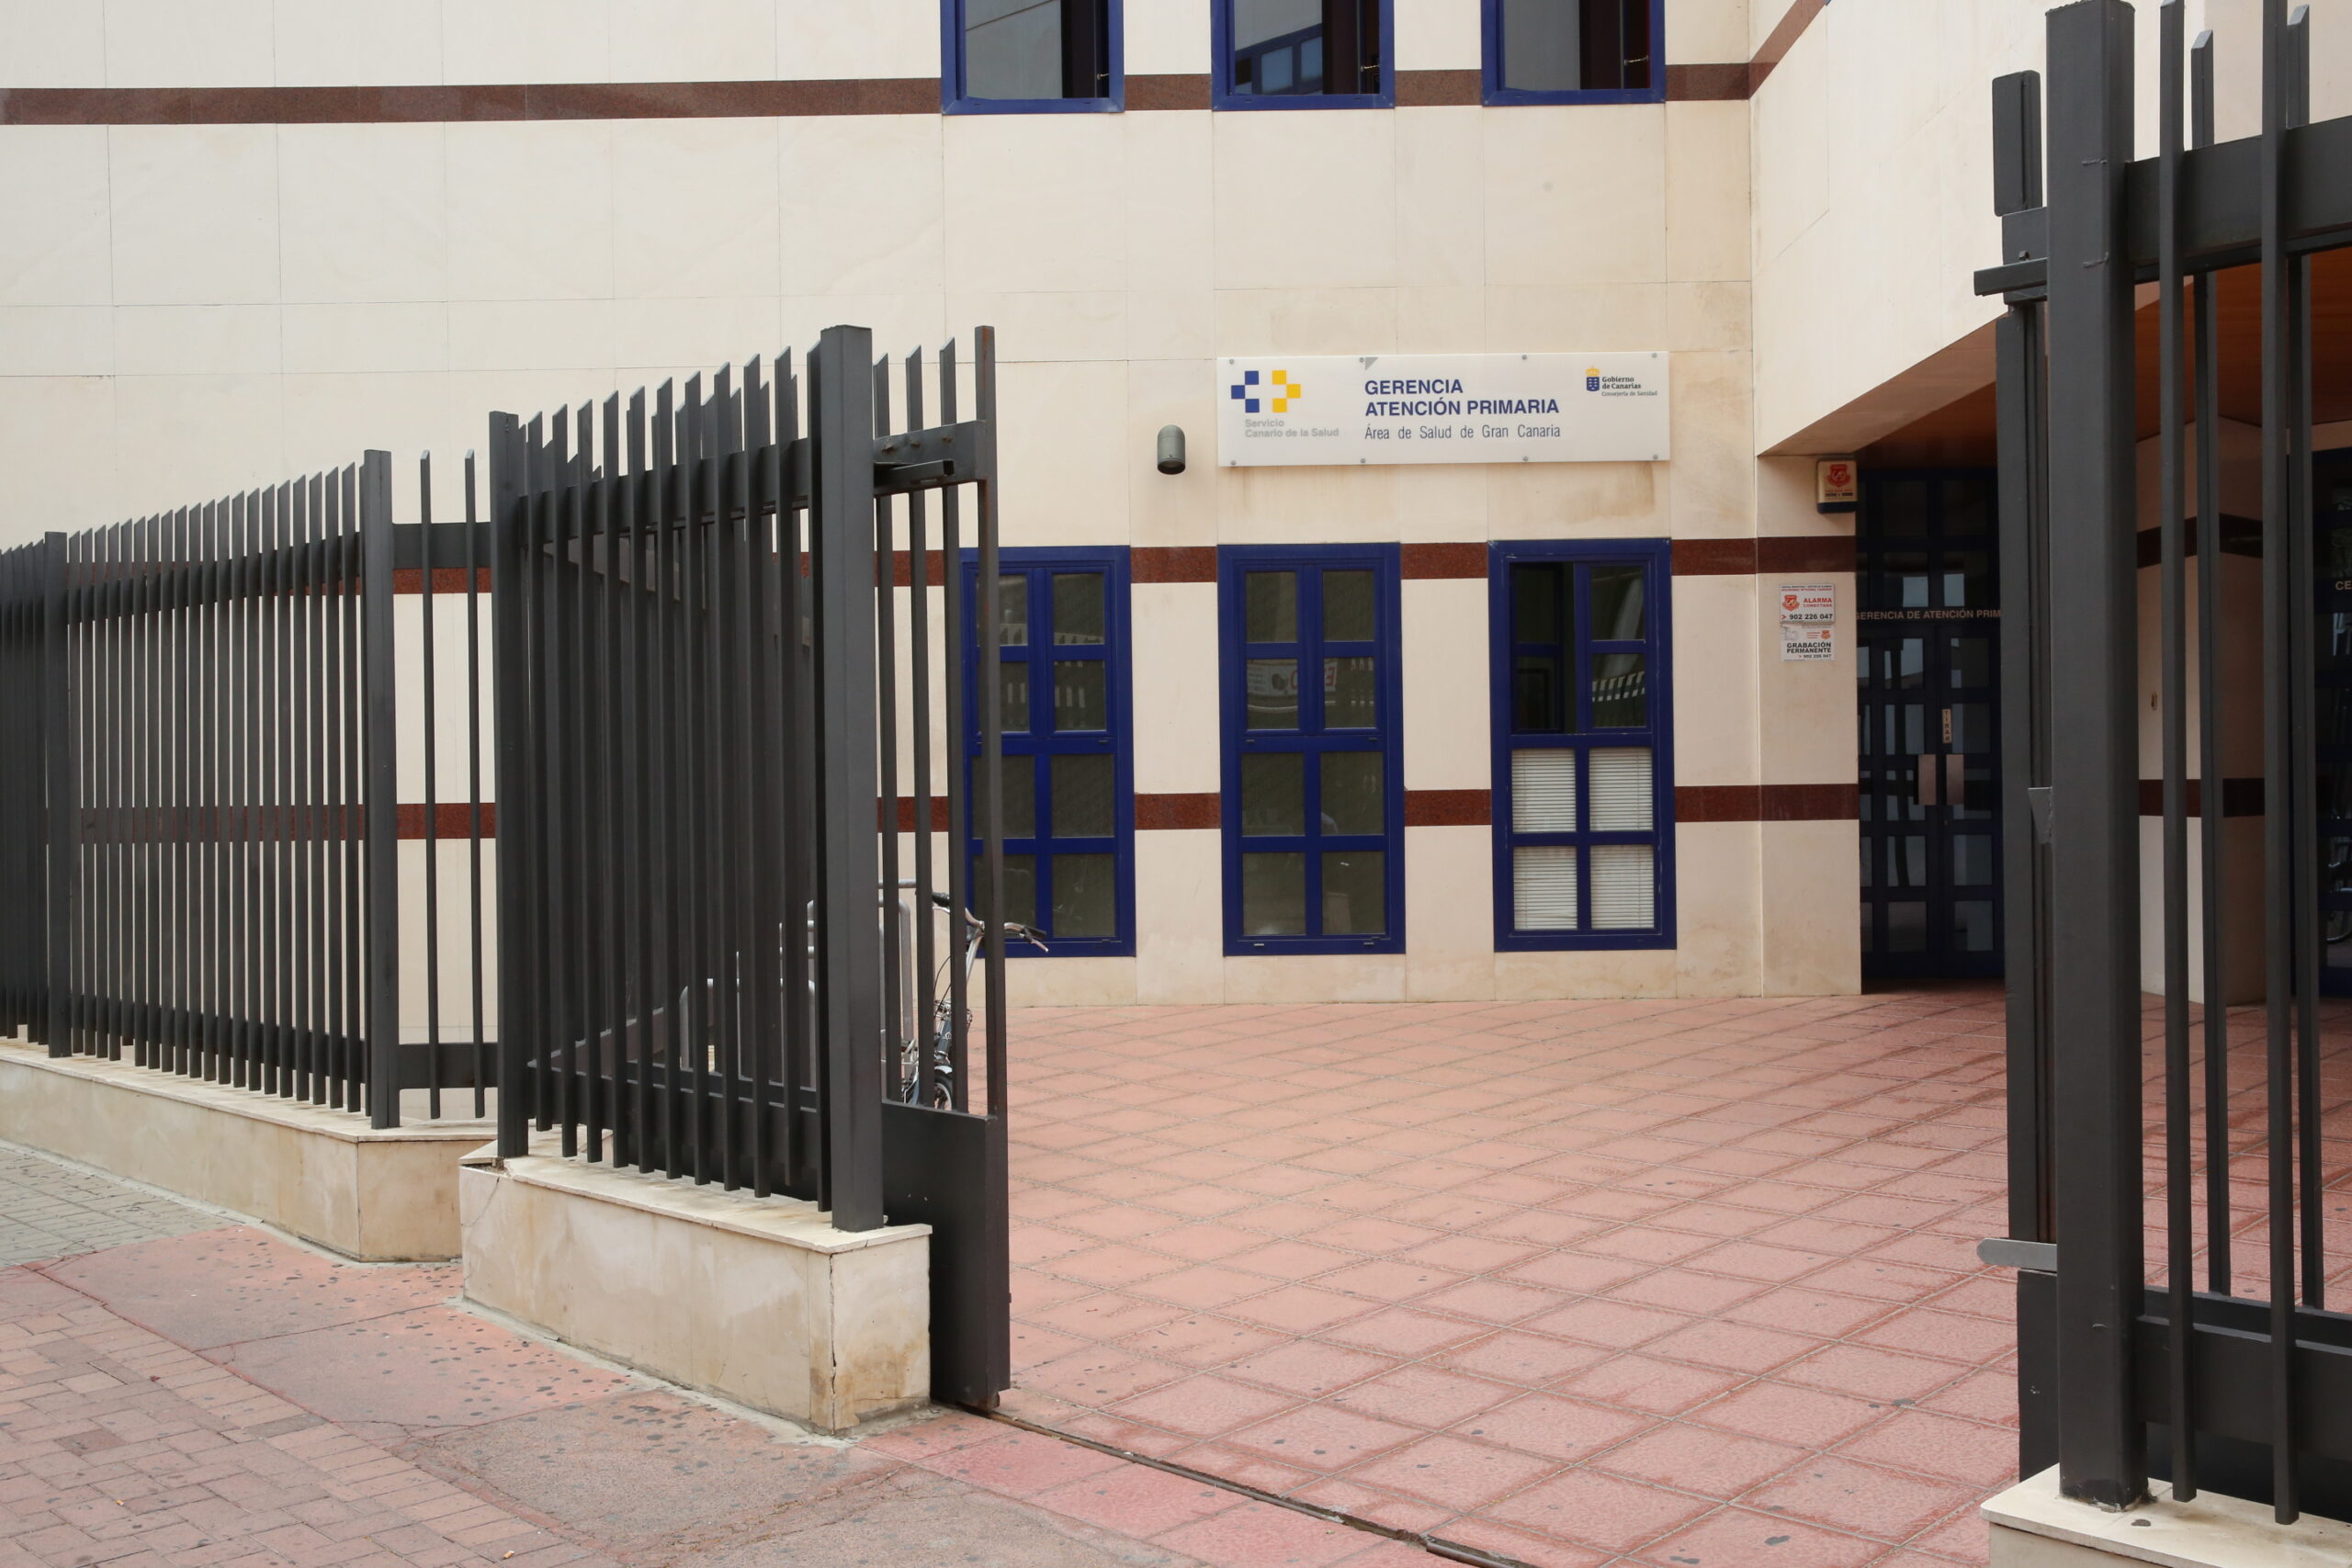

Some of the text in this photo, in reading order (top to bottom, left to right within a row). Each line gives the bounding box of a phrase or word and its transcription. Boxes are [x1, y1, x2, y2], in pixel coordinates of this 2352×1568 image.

[1364, 378, 1464, 395] GERENCIA
[1365, 397, 1560, 416] ATENCIÓN PRIMARIA
[1245, 418, 1284, 427] Servicio
[1245, 427, 1340, 438] Canario de la Salud
[1364, 423, 1561, 440] Área de Salud de Gran Canaria
[1906, 610, 1921, 619] DE
[1923, 608, 1973, 618] ATENCIÓN
